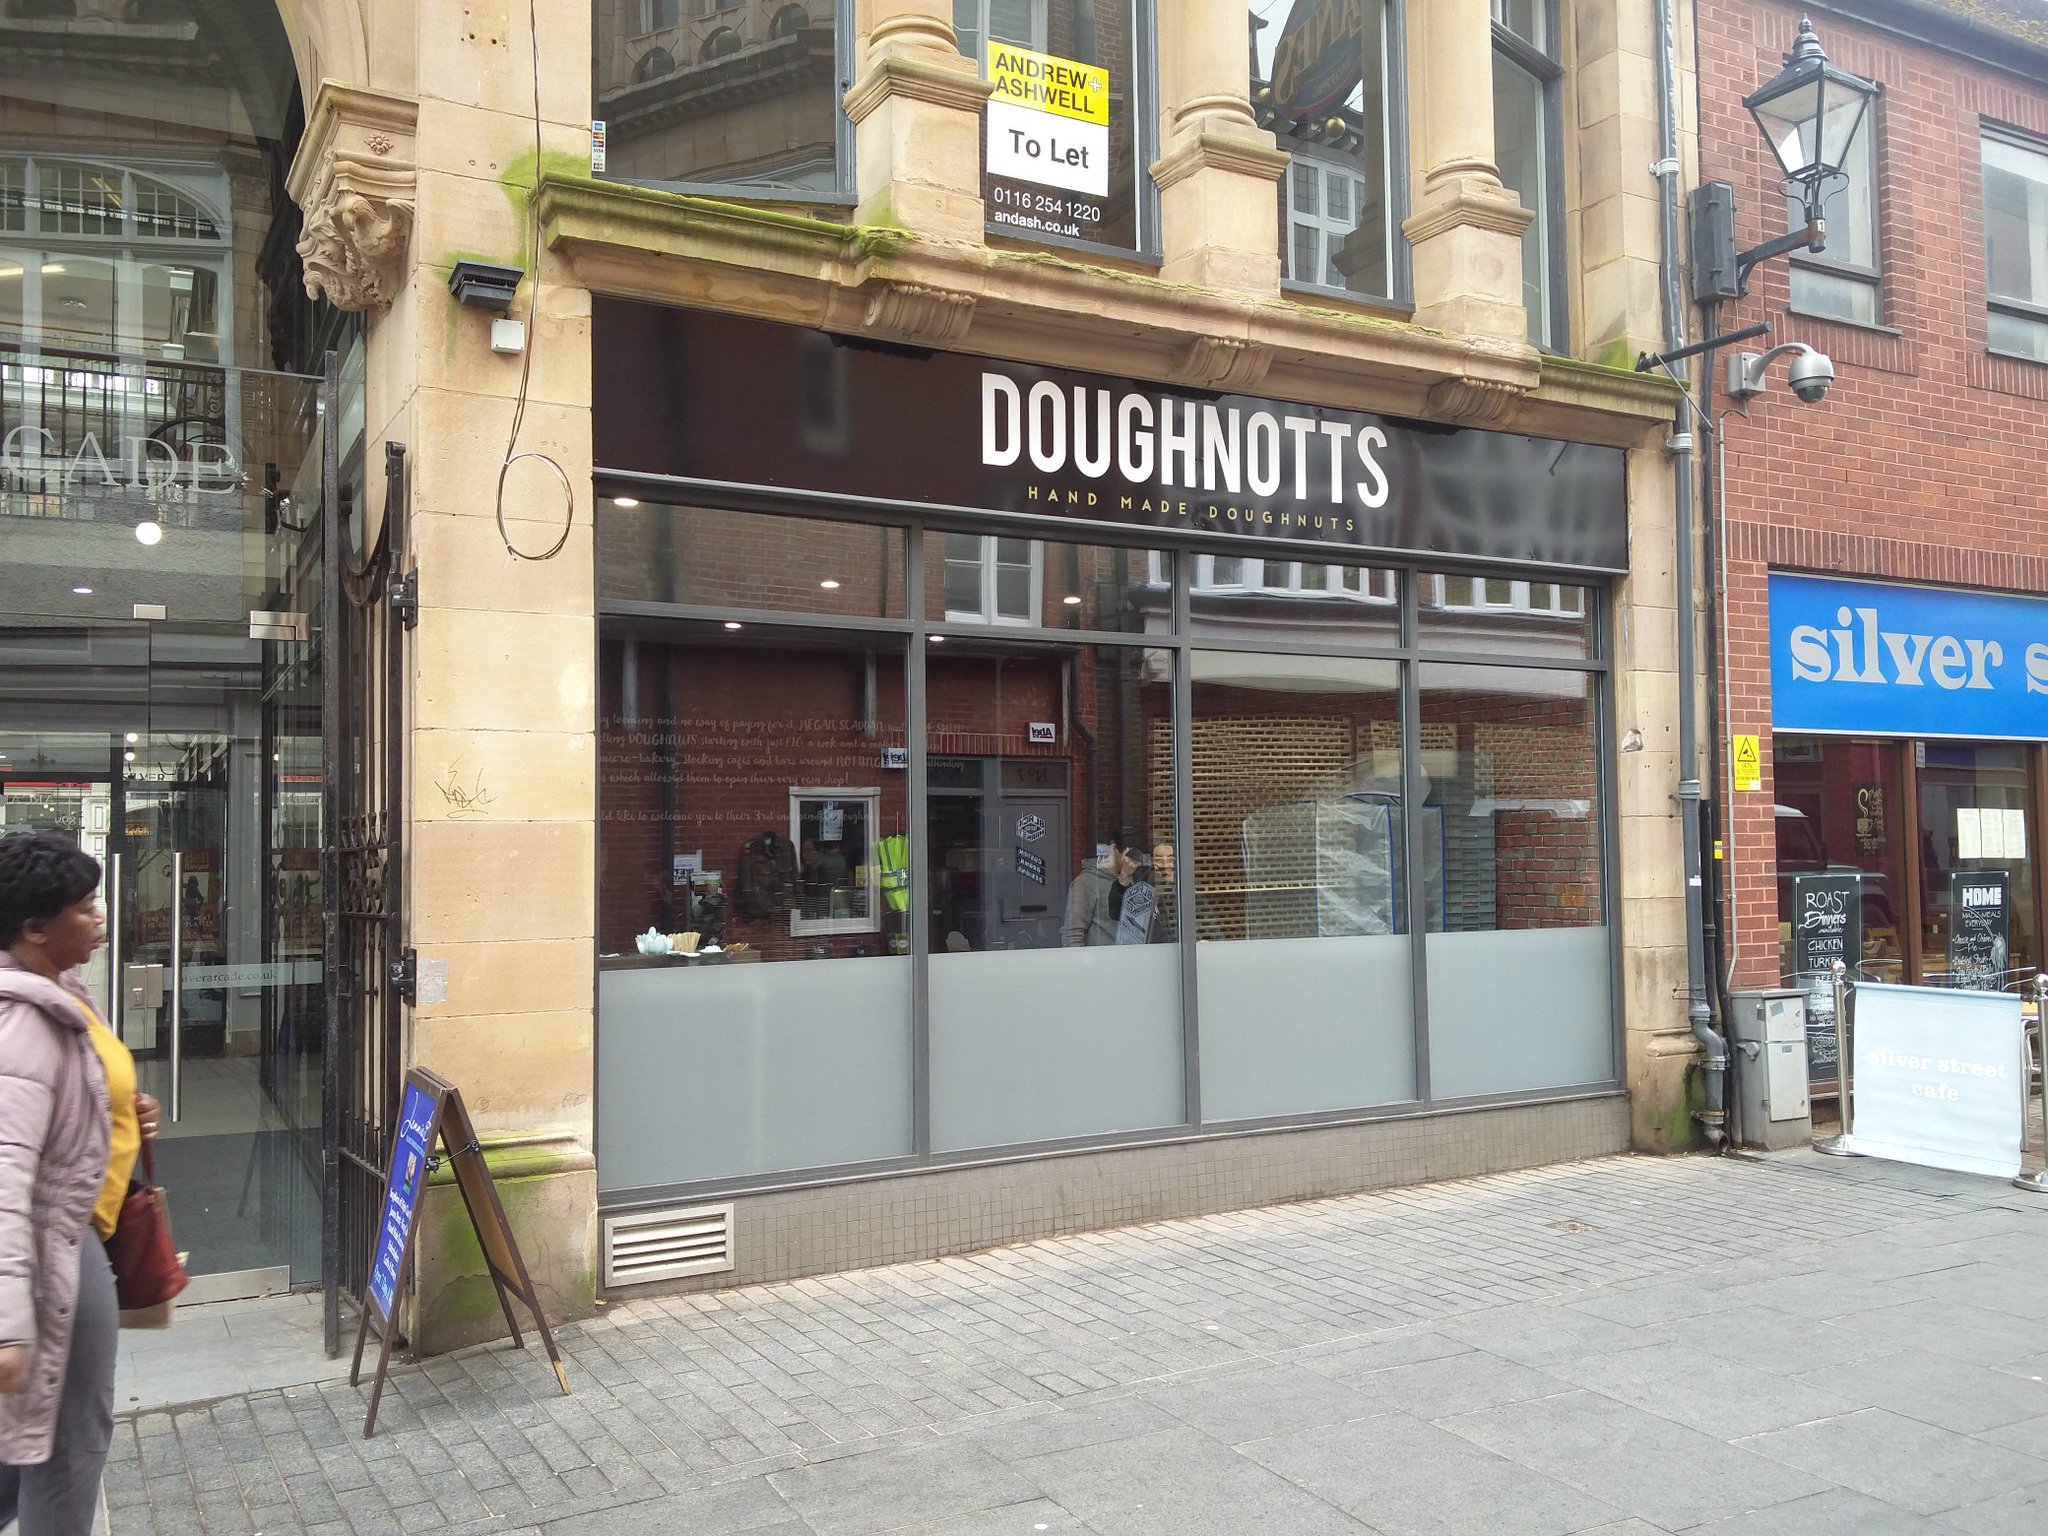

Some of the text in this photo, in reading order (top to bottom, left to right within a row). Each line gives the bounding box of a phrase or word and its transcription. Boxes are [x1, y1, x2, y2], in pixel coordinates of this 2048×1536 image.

[995, 52, 1088, 90] ANDREW
[995, 75, 1095, 115] ASHWELL
[1008, 128, 1089, 169] To Let
[994, 187, 1101, 222] 0116 254 1220
[994, 210, 1080, 237] andash.co.uk
[981, 372, 1389, 509] DOUGHNOTTS
[1027, 485, 1354, 532] HAND MADE DOUGHNUTS
[1790, 605, 2004, 691] silver
[695, 718, 717, 732] way
[720, 718, 731, 732] of
[732, 719, 765, 733] paying
[767, 720, 785, 733] for
[798, 718, 838, 732] MEGAN
[700, 736, 738, 750] starting
[741, 735, 763, 747] with
[765, 739, 783, 755] just
[724, 776, 748, 789] open
[650, 809, 694, 822] welcome
[695, 813, 714, 827] you
[1805, 890, 1850, 914] ROAST
[1962, 886, 2002, 907] HOME
[1798, 910, 1847, 929] Dinners
[1807, 938, 1844, 952] CHICKEN
[1866, 1049, 2008, 1080] silver street
[1911, 1082, 1961, 1101] cafe
